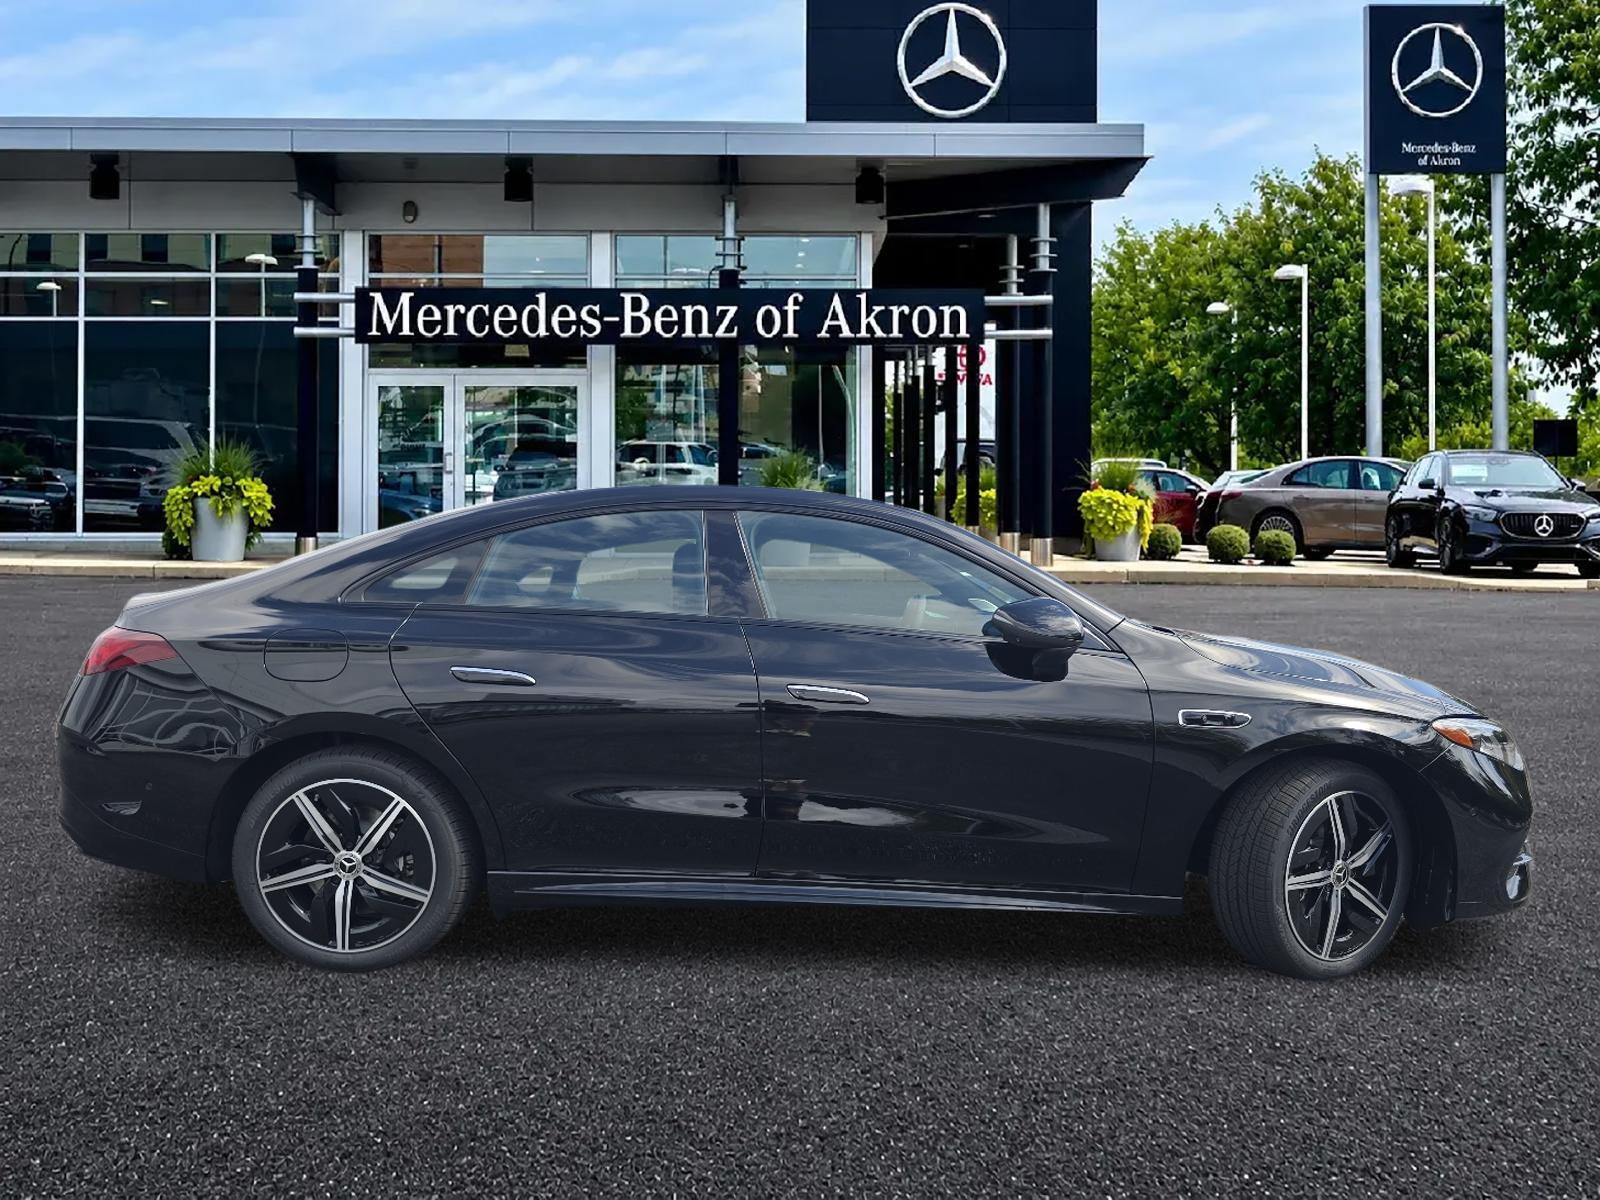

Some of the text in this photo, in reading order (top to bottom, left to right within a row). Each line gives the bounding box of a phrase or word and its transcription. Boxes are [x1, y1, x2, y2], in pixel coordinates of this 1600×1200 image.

[1402, 141, 1476, 153] Mercedes-Benz
[1418, 154, 1460, 165] of Akron
[368, 292, 970, 339] Mercedes-Benz of Akron
